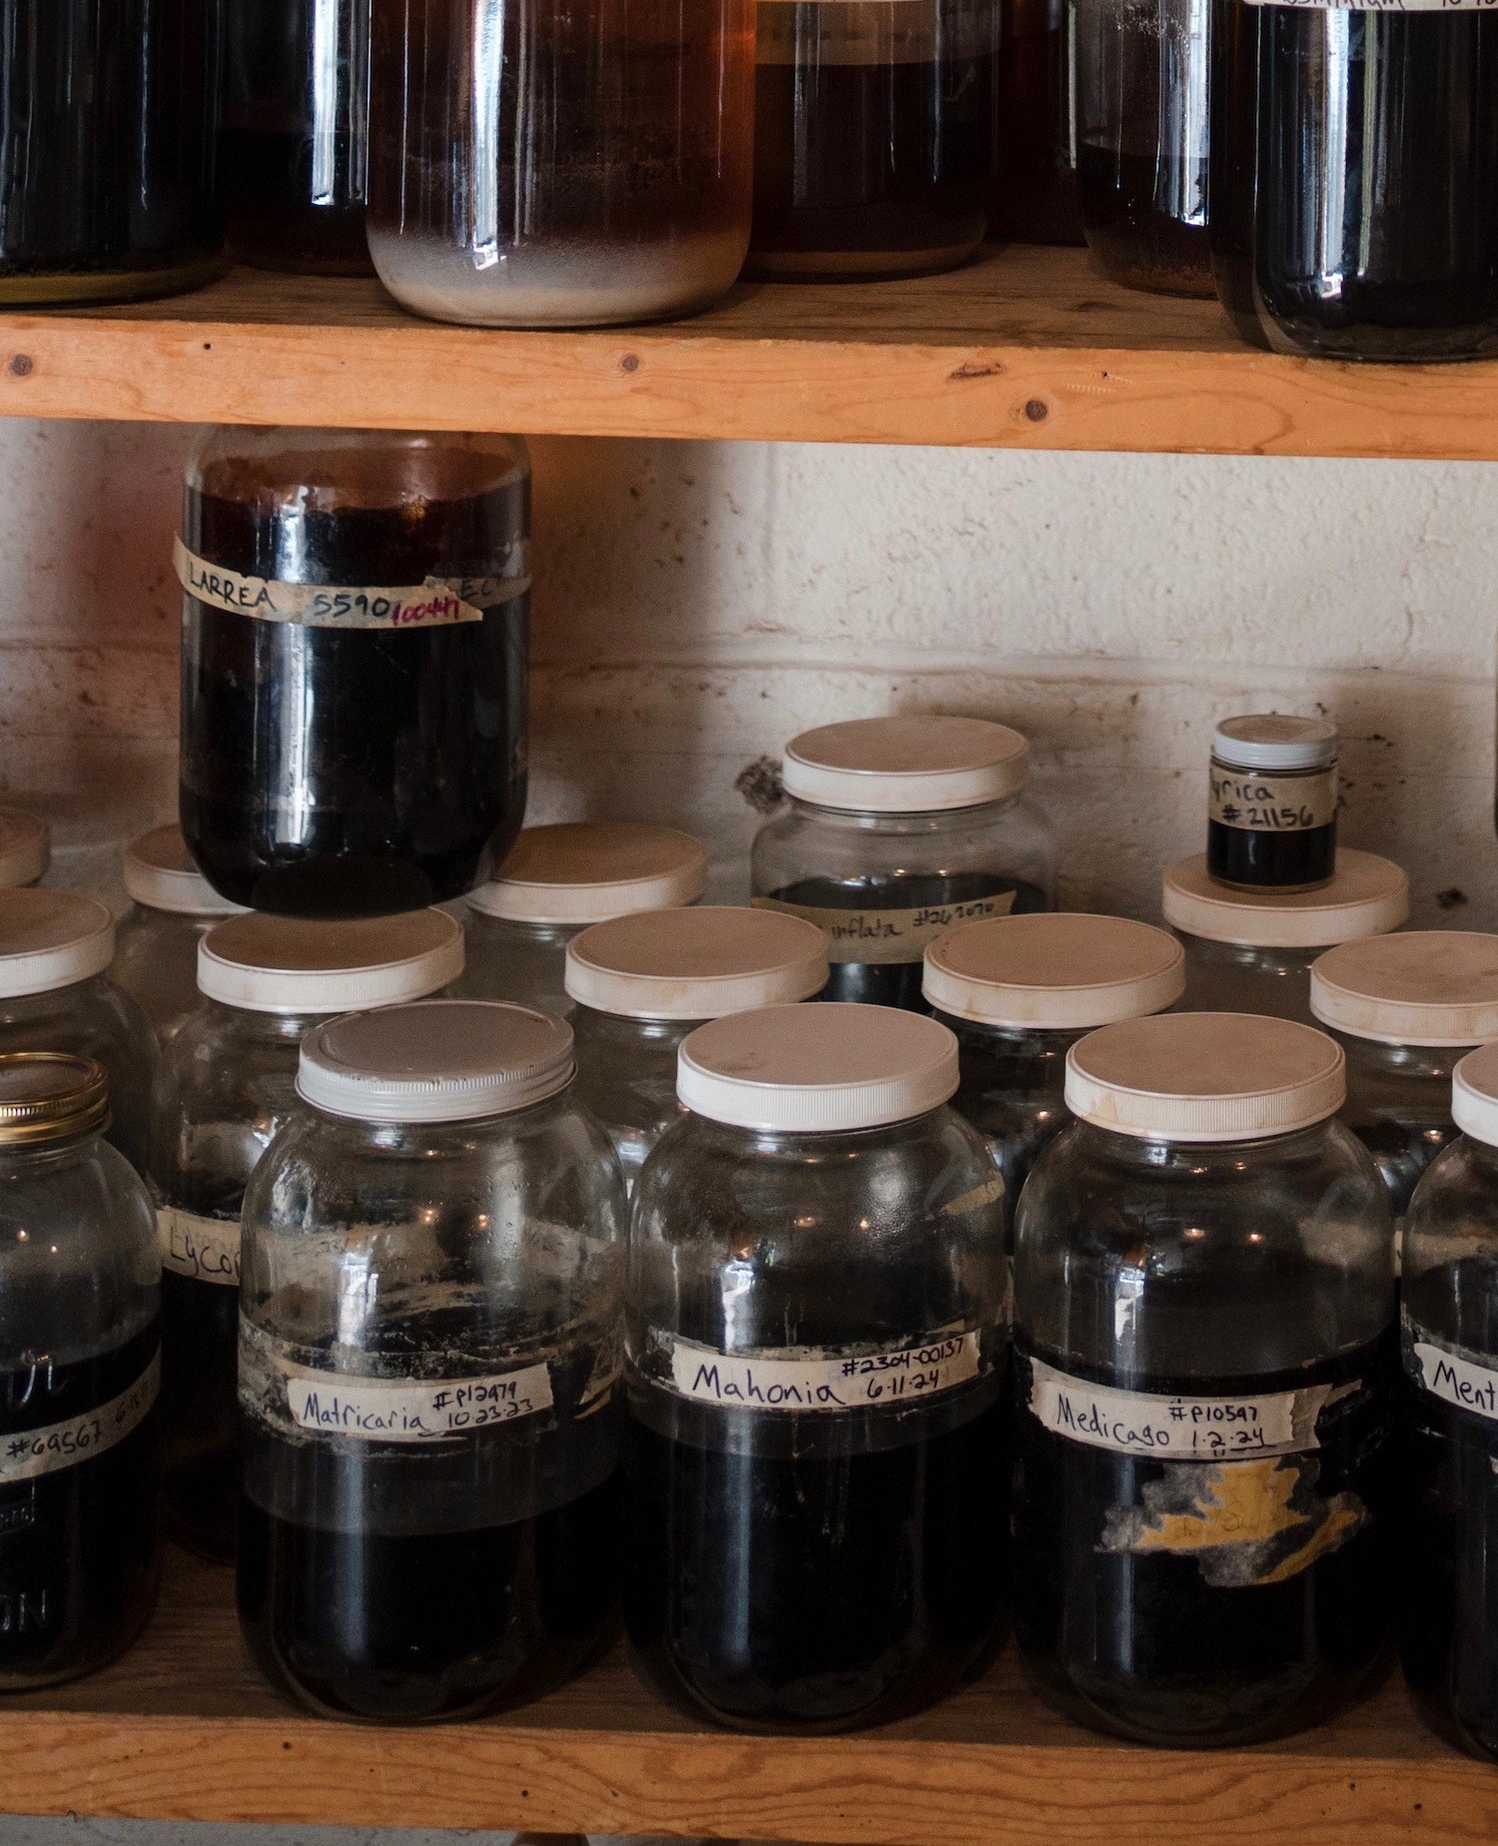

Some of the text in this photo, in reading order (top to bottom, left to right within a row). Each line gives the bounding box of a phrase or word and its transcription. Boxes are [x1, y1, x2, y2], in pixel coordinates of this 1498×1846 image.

[189, 560, 277, 612] LARREA
[691, 1362, 846, 1406] Mahonia
[303, 1391, 429, 1432] Matricaria
[1056, 1392, 1170, 1448] Medicago
